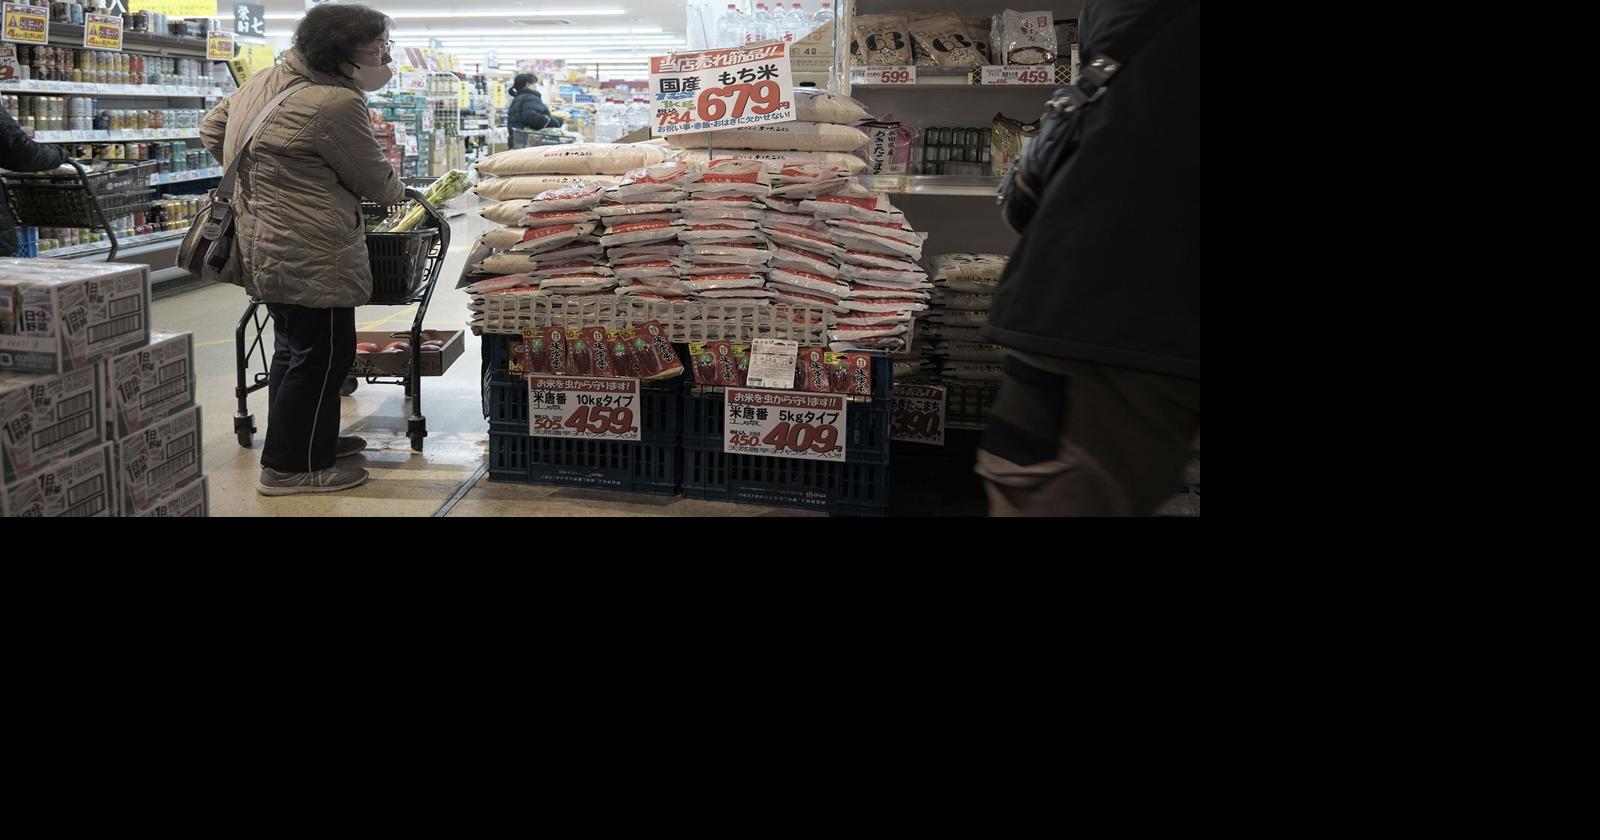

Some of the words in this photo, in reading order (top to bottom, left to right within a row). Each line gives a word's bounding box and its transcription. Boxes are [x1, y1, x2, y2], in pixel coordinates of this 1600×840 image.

[660, 76, 701, 93] 国産
[718, 64, 779, 85] もち米
[534, 391, 567, 405] 米唐番
[729, 405, 768, 421] 米唐番
